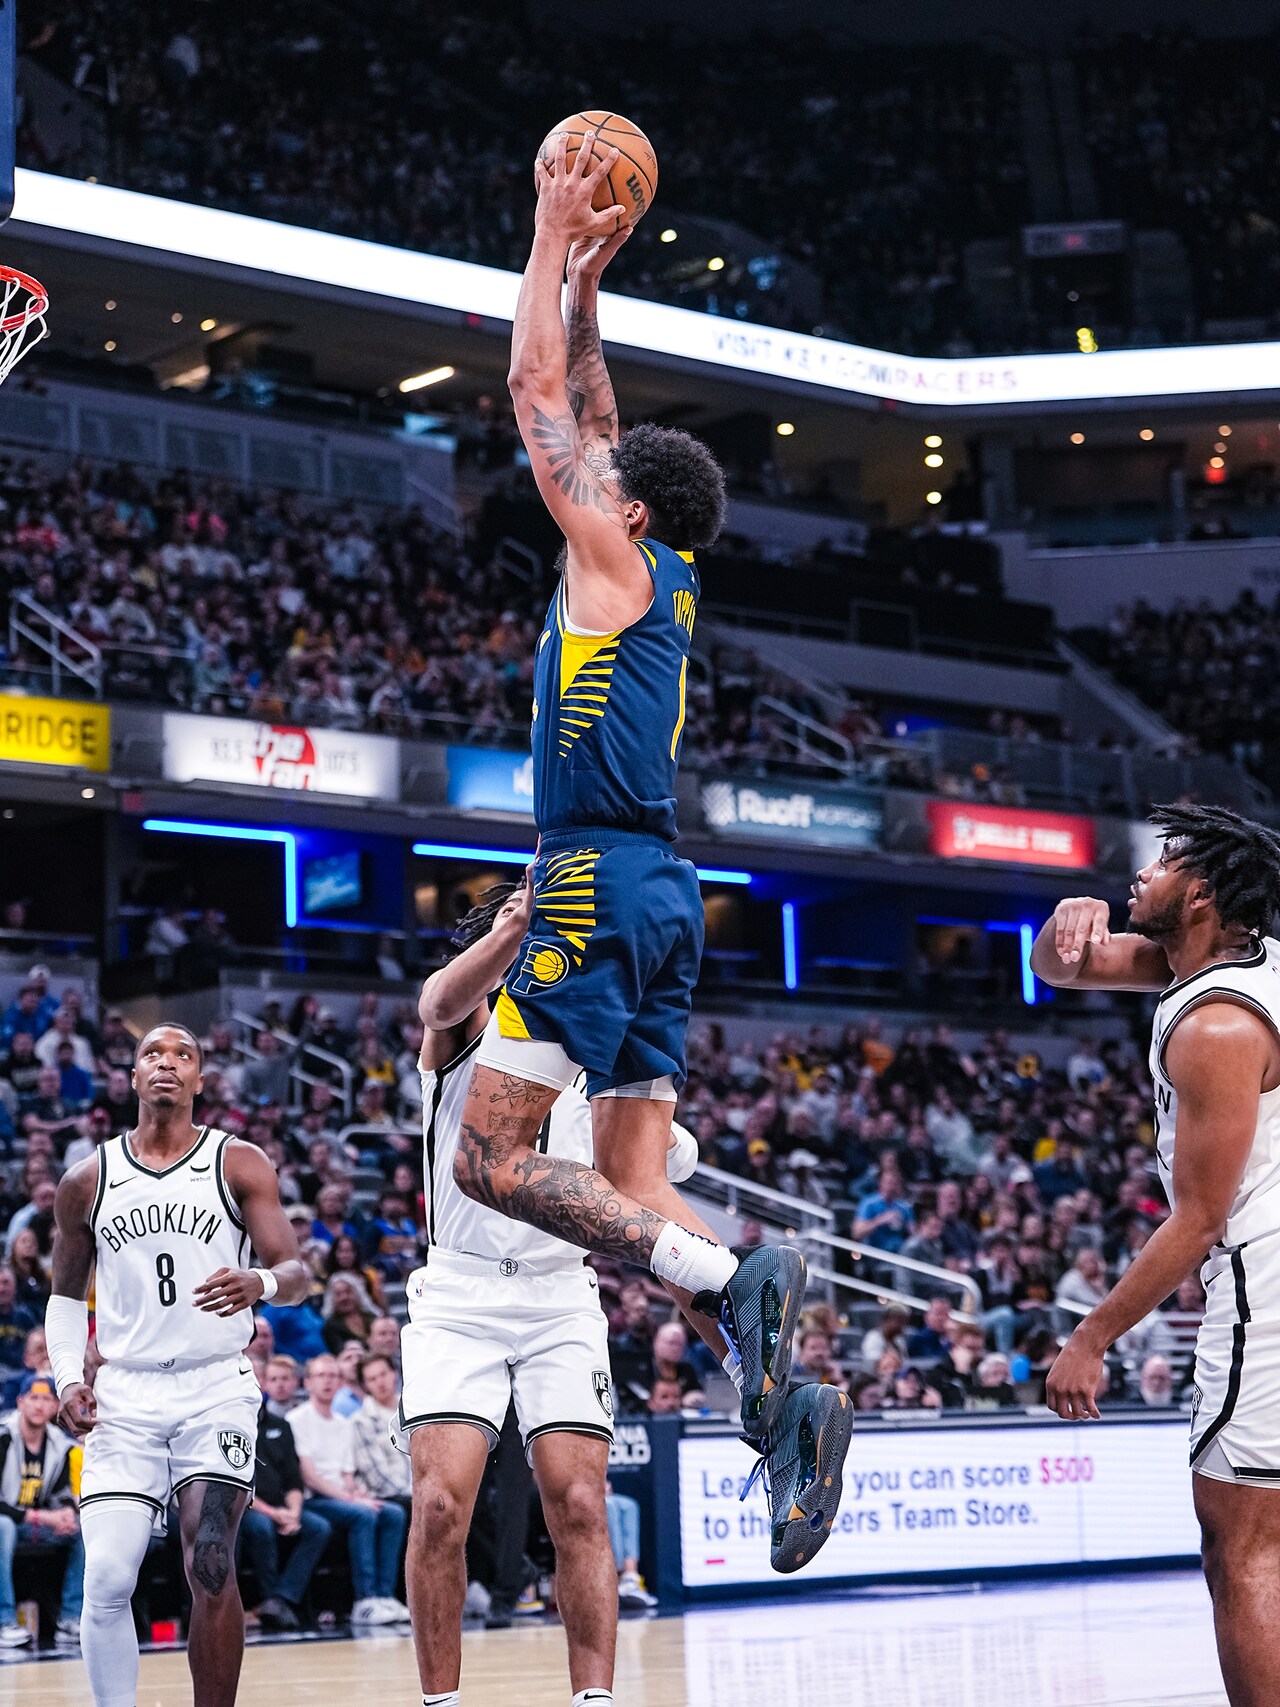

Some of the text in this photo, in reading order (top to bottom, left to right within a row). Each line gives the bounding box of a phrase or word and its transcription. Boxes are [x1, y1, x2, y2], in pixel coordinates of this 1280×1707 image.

[100, 1203, 222, 1253] BROOKLYN
[156, 1252, 177, 1307] 8
[221, 1432, 251, 1456] NETS
[702, 1456, 1095, 1500] Lear you can score $500
[704, 1515, 730, 1540] to
[740, 1508, 772, 1538] th
[891, 1502, 957, 1531] Team
[966, 1499, 1039, 1527] Store.
